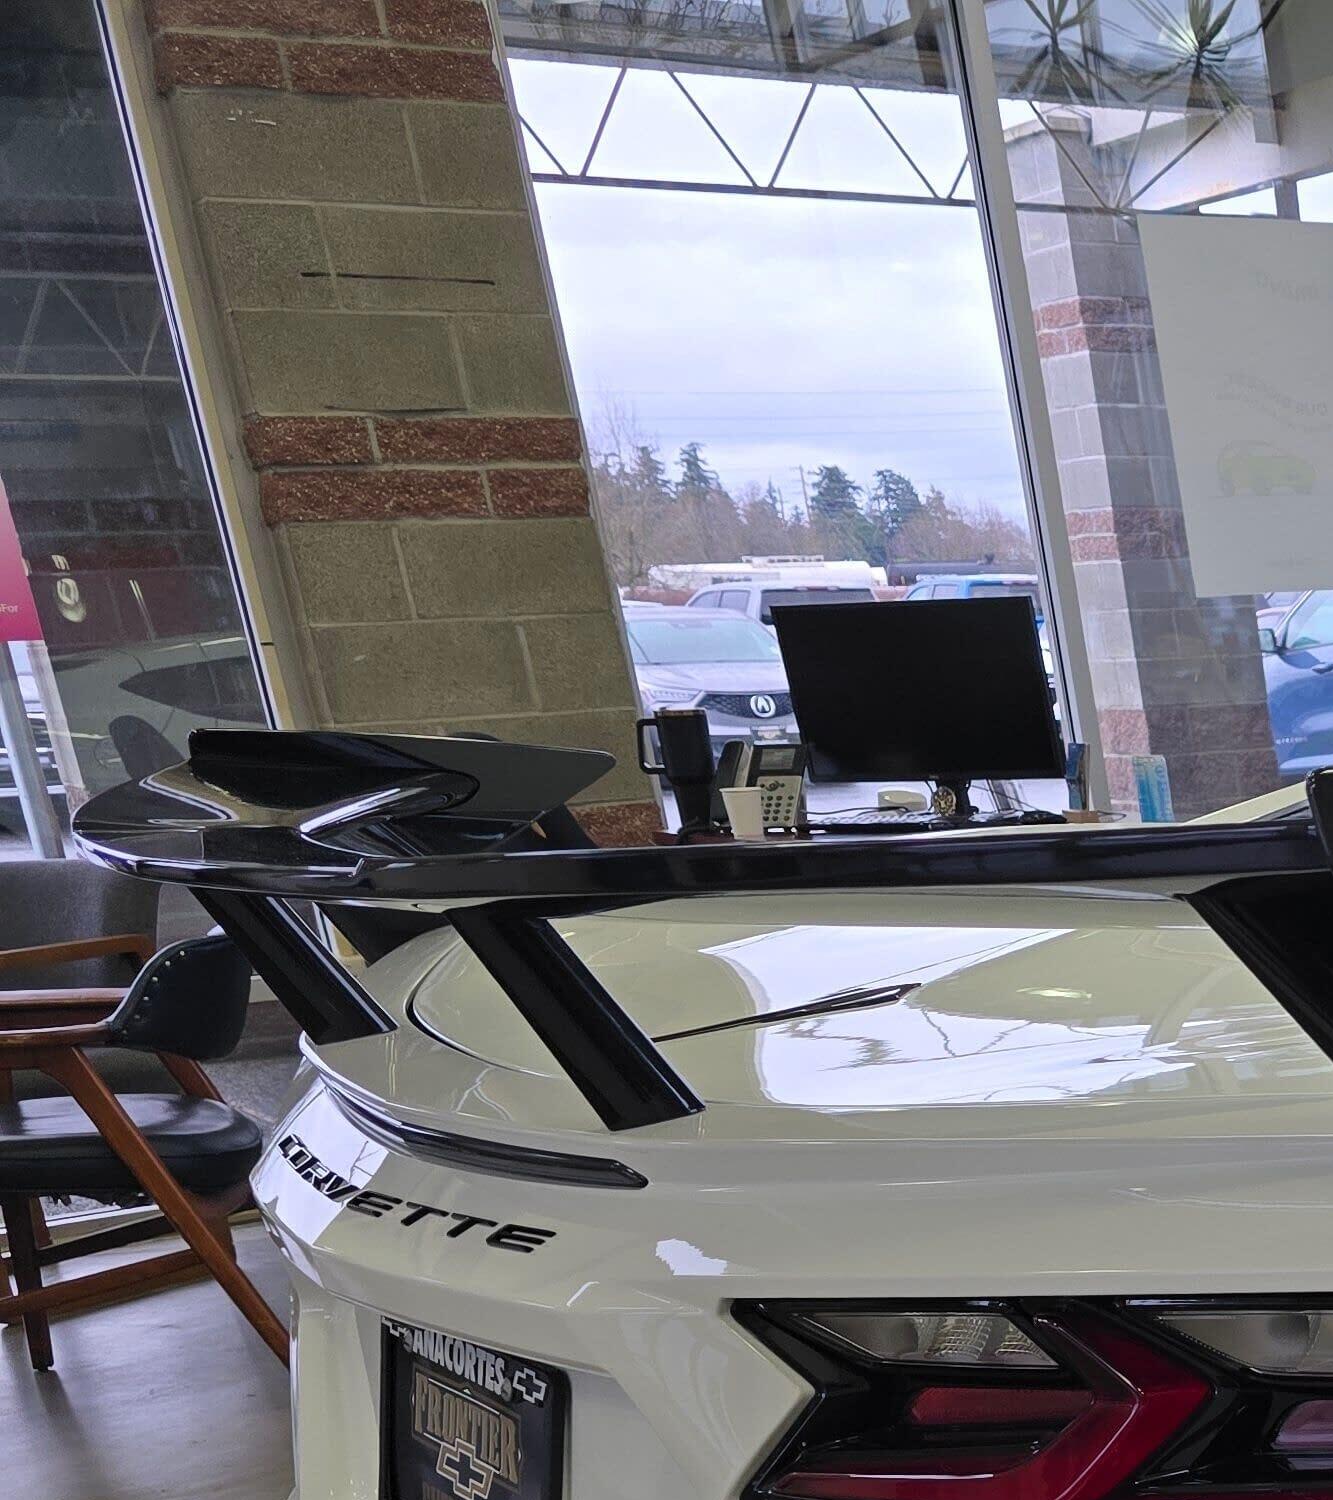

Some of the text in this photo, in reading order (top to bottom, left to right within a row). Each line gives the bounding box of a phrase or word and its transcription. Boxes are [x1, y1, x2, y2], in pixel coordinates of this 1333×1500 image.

[278, 1133, 557, 1254] CORVETTE
[412, 1328, 506, 1396] ANACORTES
[414, 1371, 518, 1485] FRONTIER
